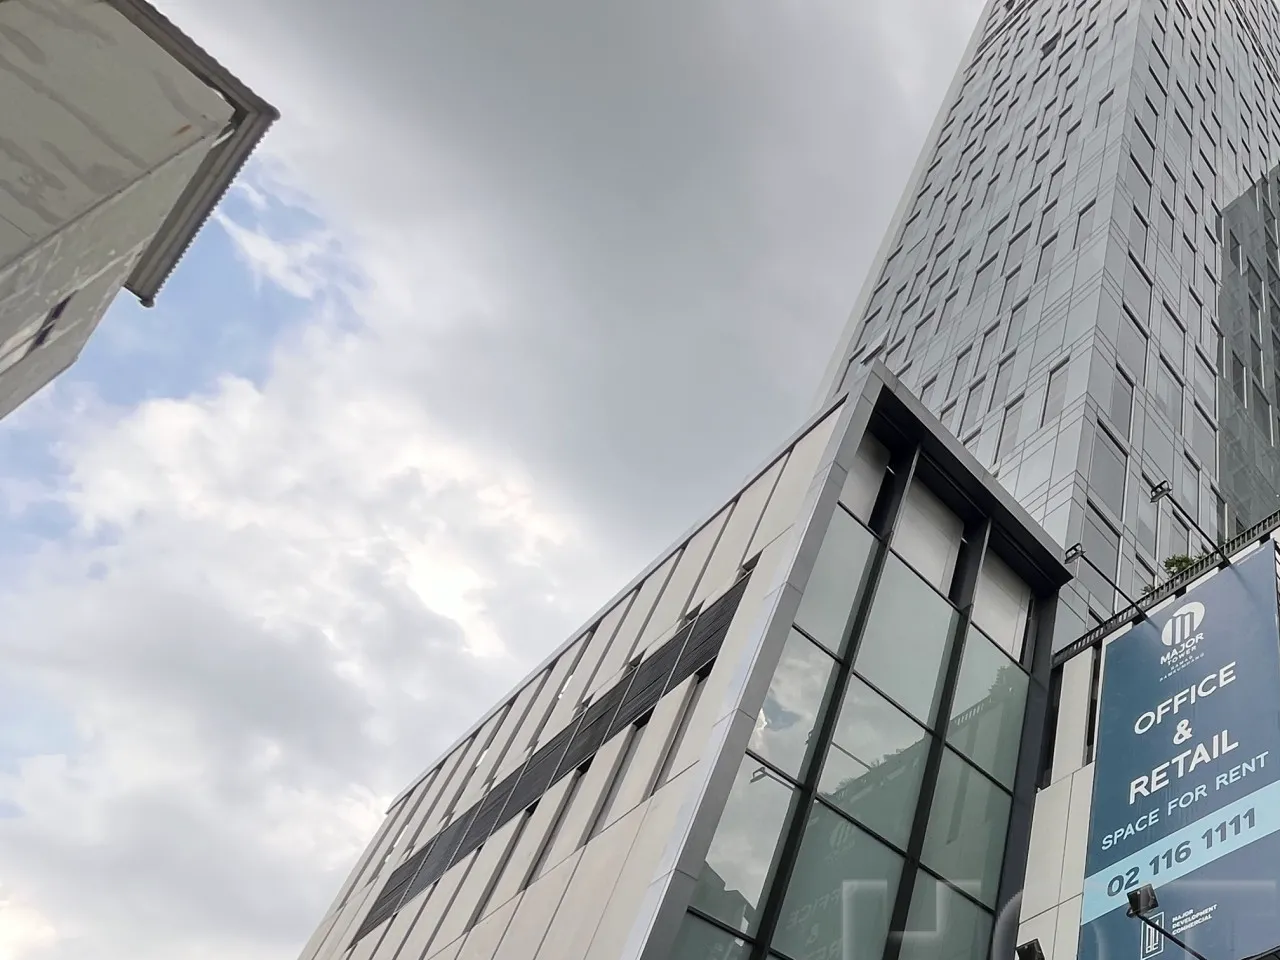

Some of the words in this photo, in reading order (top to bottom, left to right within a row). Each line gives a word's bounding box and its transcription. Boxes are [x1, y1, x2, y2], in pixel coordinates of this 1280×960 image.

[1160, 632, 1205, 665] MAJOR
[1166, 646, 1197, 666] TOWER
[1134, 661, 1237, 735] OFFICE
[1172, 718, 1193, 745] &
[1128, 729, 1239, 805] RETAIL
[1101, 808, 1160, 851] SPACE
[1167, 784, 1208, 816] FOR
[1216, 751, 1269, 791] RENT
[1106, 866, 1140, 897] 02
[1148, 840, 1191, 875] 116
[1201, 808, 1256, 849] 1111
[1171, 908, 1194, 923] MAJOR
[1171, 904, 1218, 929] DEVELOPMENT
[1171, 913, 1213, 936] COMMERCIAL
